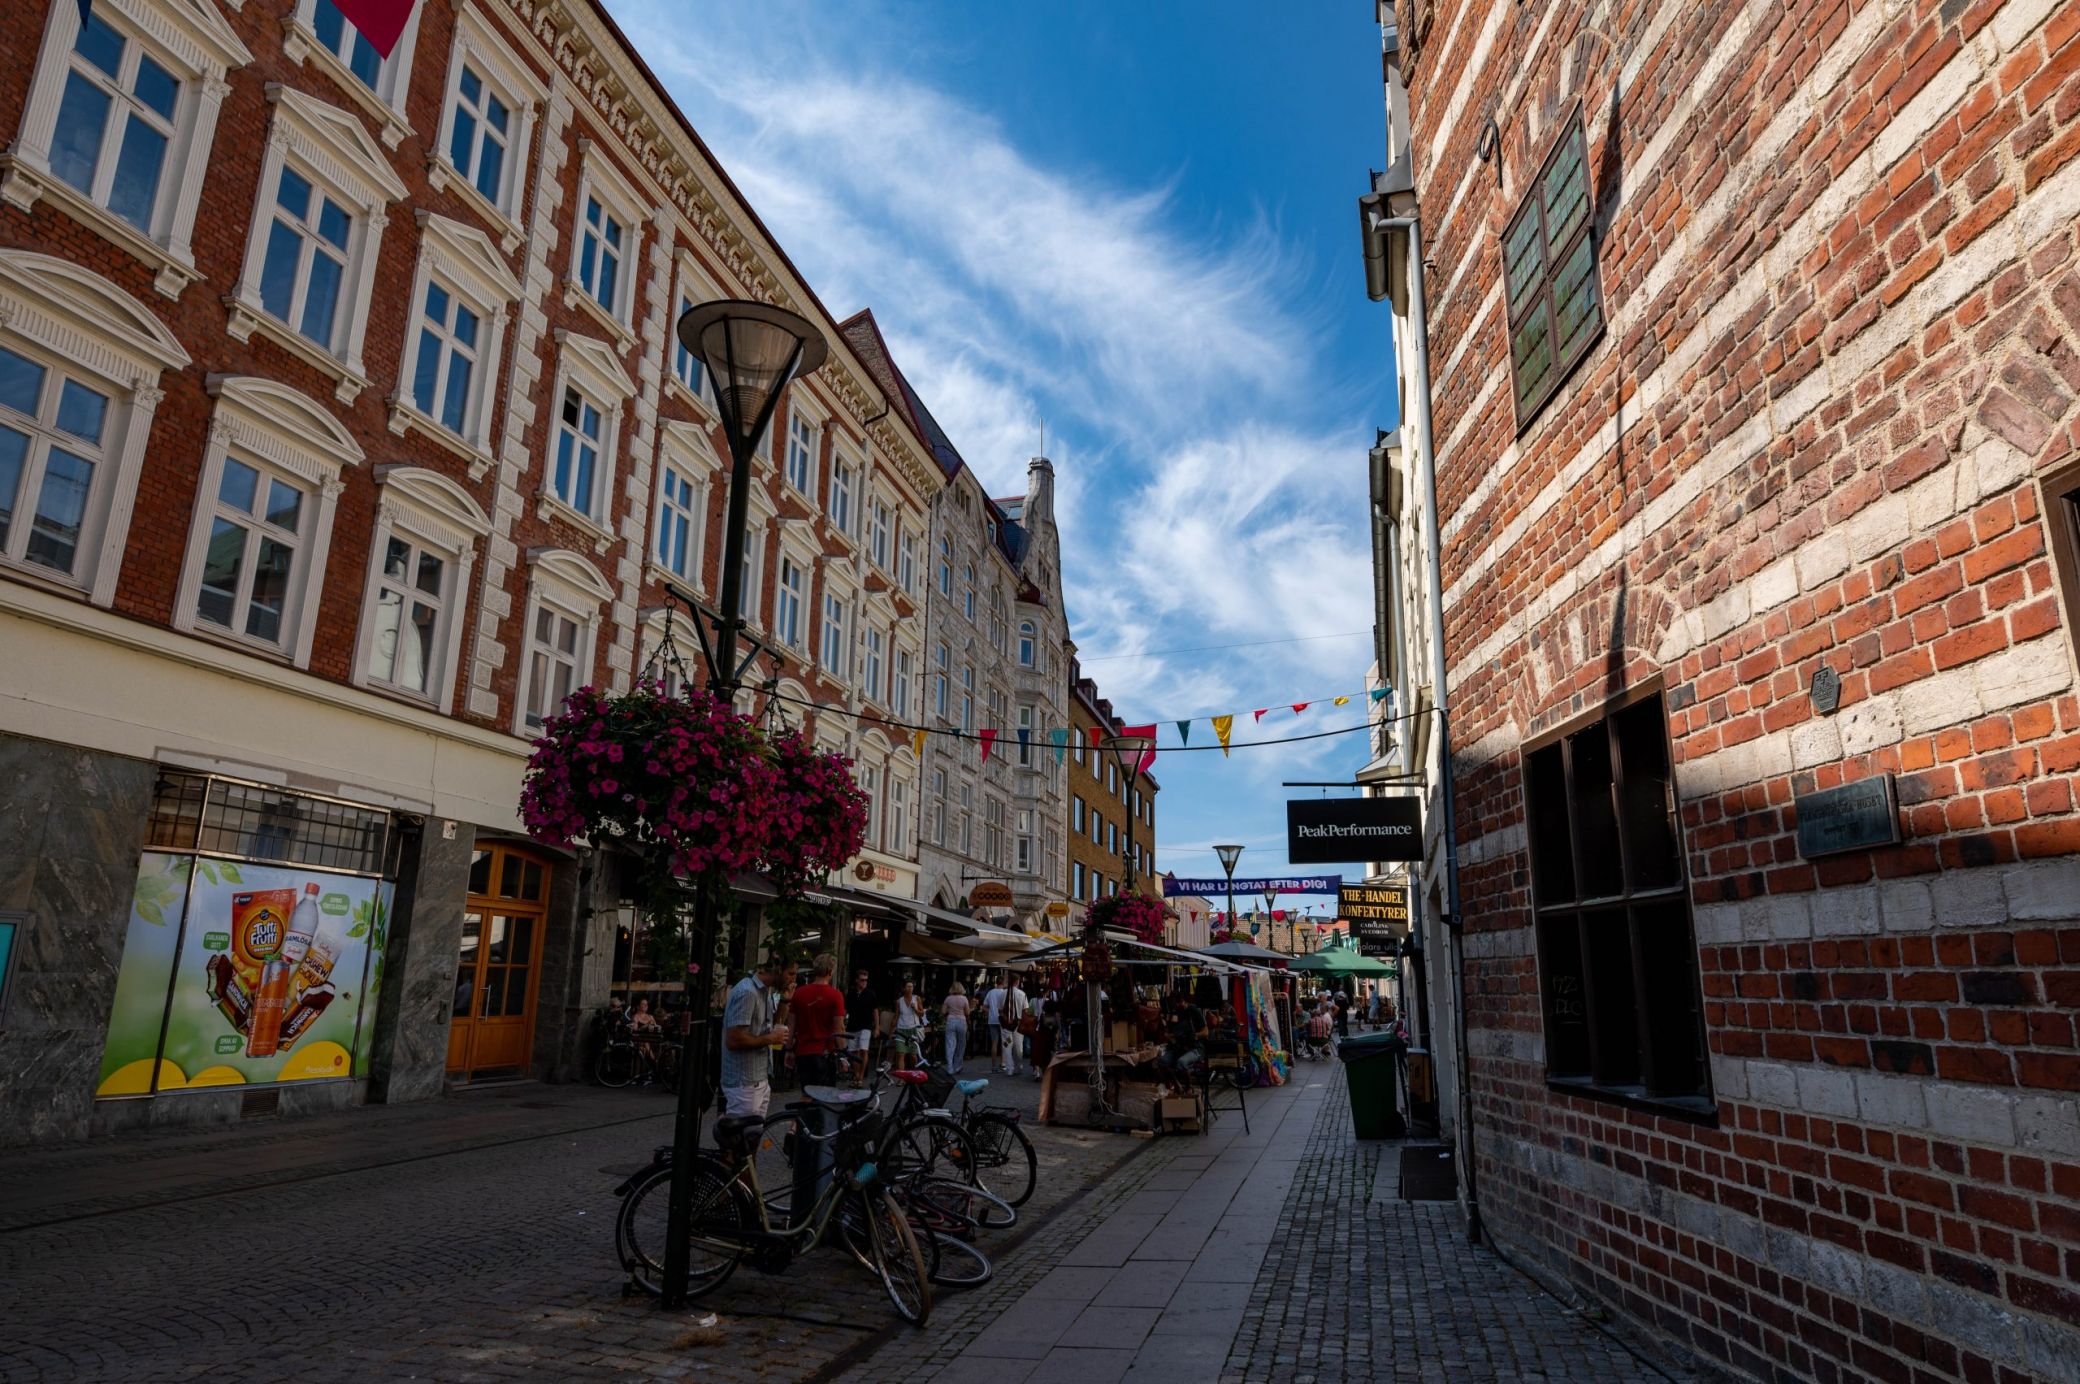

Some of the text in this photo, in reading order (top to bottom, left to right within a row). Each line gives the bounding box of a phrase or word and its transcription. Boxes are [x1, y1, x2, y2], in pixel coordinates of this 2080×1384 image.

[1297, 823, 1412, 838] PeakPerformance
[1178, 882, 1190, 891] VI
[1192, 882, 1216, 892] HAR
[1269, 880, 1300, 890] EFTER
[1302, 879, 1328, 890] DIG!
[1339, 904, 1407, 919] KONFEKTYRER
[253, 921, 278, 935] Tutti
[250, 931, 278, 946] Frutti
[304, 956, 330, 978] CASHEW
